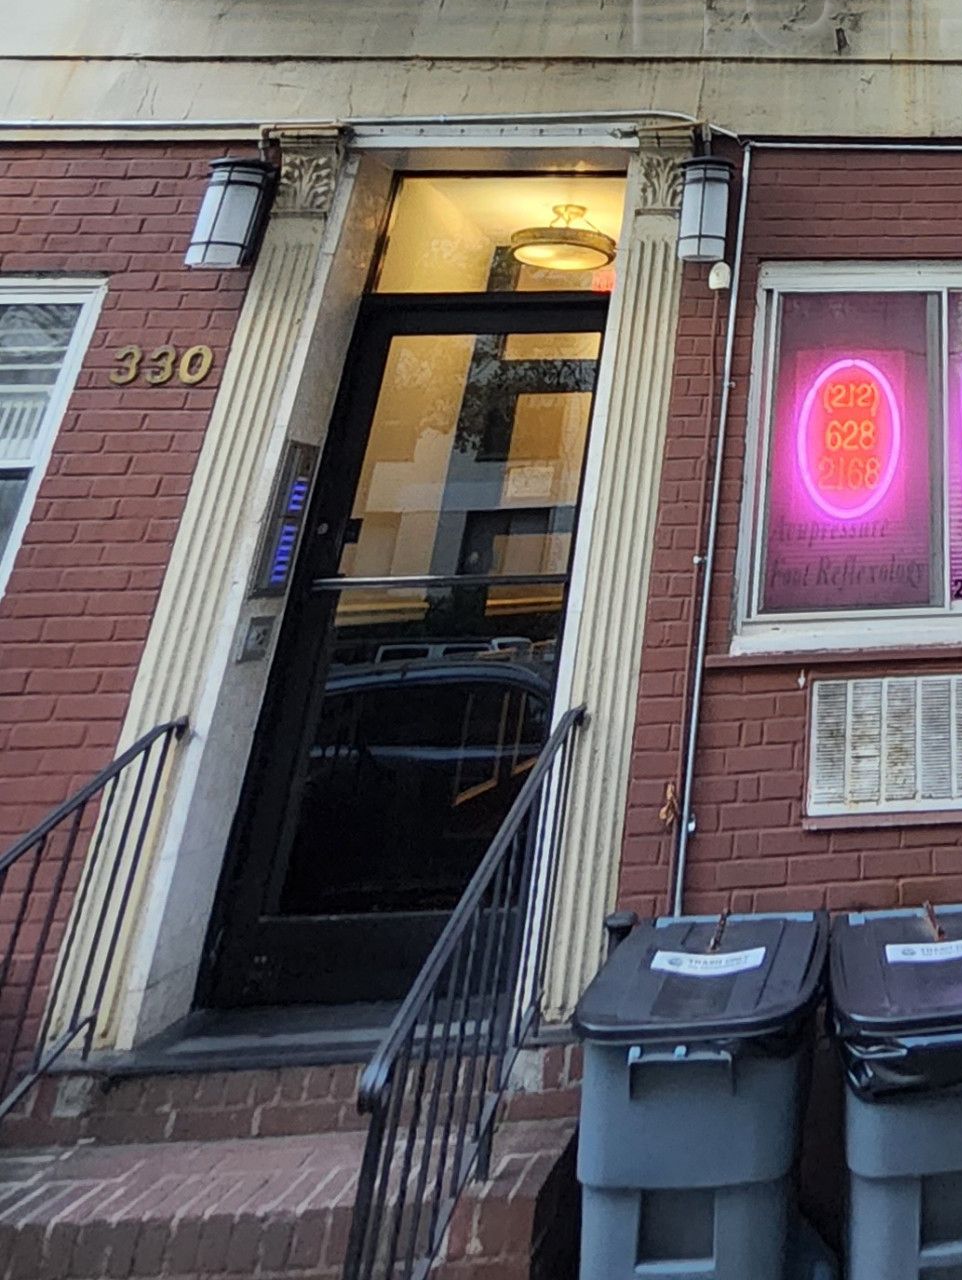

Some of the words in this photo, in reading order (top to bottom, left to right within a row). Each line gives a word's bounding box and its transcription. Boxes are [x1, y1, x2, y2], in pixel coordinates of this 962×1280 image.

[109, 344, 213, 384] 330
[823, 383, 879, 417] (212)
[826, 419, 875, 452] 628
[818, 456, 881, 490] 2168
